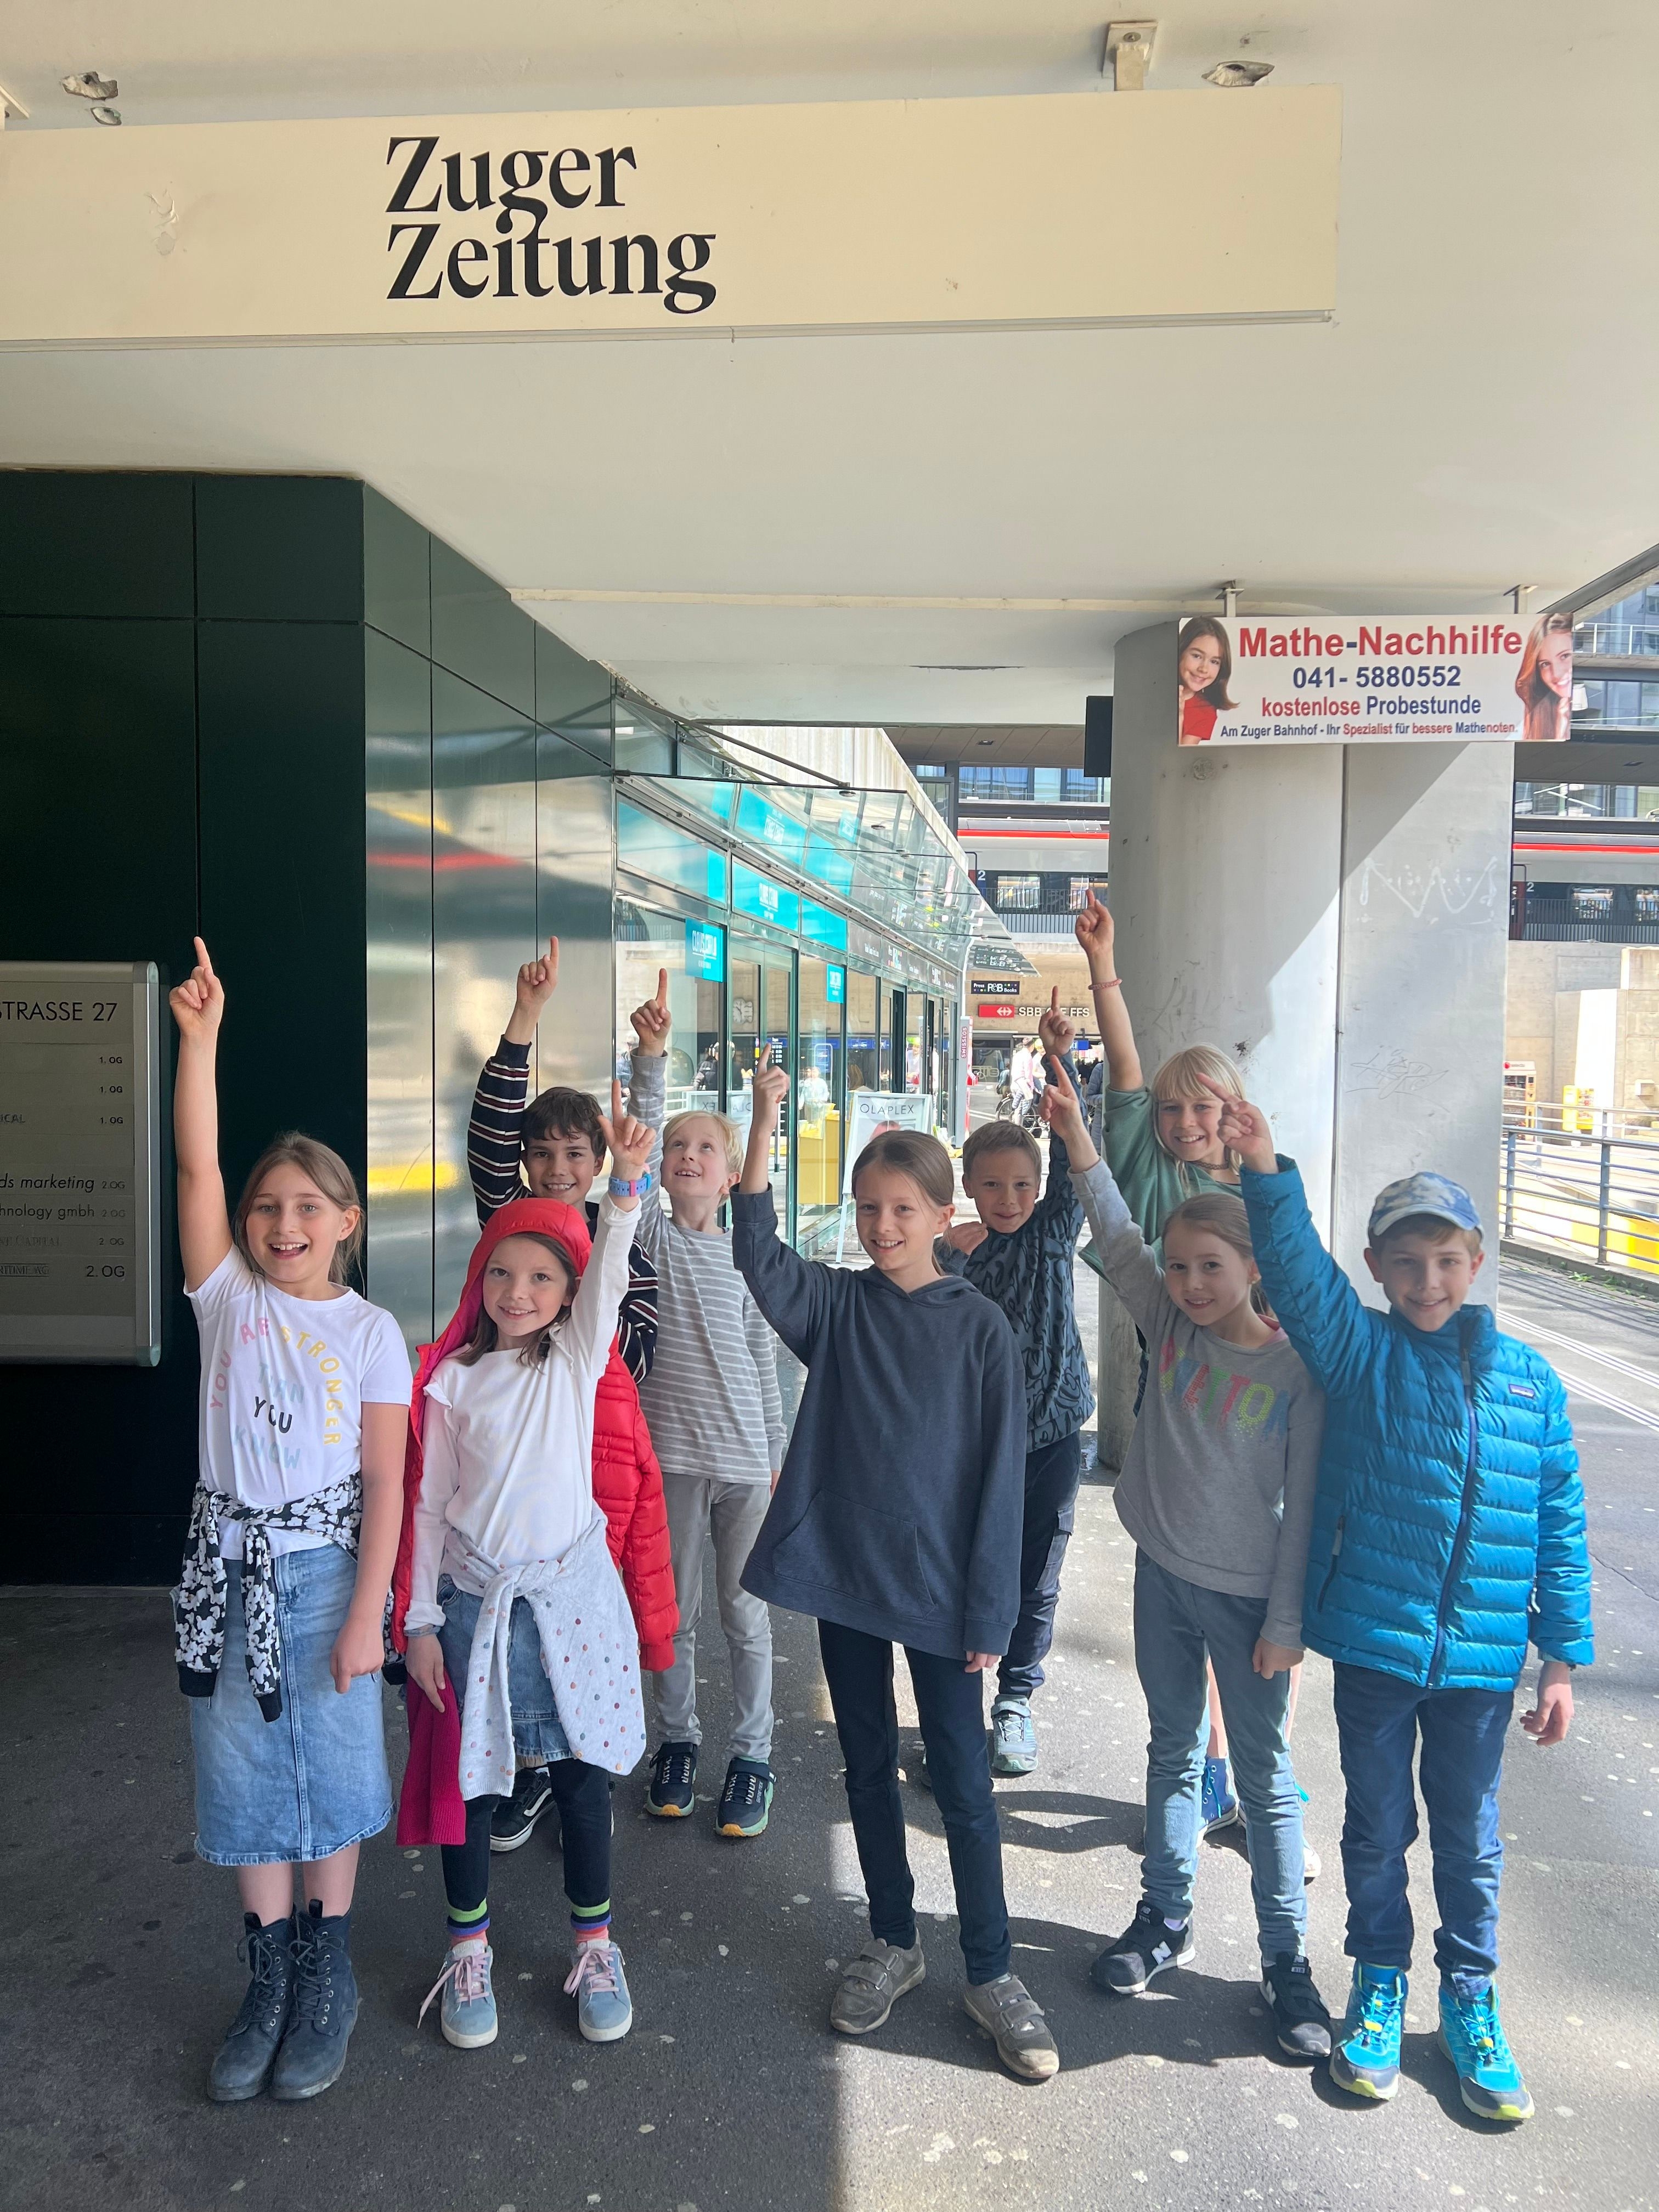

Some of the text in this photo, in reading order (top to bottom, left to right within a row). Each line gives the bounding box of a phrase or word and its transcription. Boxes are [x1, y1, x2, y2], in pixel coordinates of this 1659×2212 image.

[385, 136, 637, 234] Zuger
[386, 223, 716, 314] Zeitung
[1240, 624, 1522, 657] Mathe-Nachhilfe
[1356, 665, 1461, 687] 5880552
[1262, 695, 1481, 716] kostenlose Probestunde
[1221, 726, 1238, 737] Am
[1241, 725, 1271, 739] Zuger
[1274, 724, 1318, 736] Bahnhof
[1327, 723, 1341, 735] Ihr
[1343, 723, 1392, 737] Spezialist
[1395, 723, 1409, 734] für
[1412, 723, 1452, 733] bessere
[978, 870, 986, 881] 2
[1526, 882, 1534, 892] 2
[92, 1002, 117, 1021] 27
[1018, 1007, 1042, 1017] SBB
[1070, 1007, 1090, 1017] FFS
[860, 1103, 915, 1115] OLAPLEX
[21, 1173, 94, 1193] marketing
[58, 1204, 94, 1220] gmbh
[102, 1265, 125, 1277] OG
[210, 1350, 232, 1409] YOU
[280, 1326, 343, 1445] STRONGER
[259, 1363, 304, 1403] TAN
[1152, 1940, 1172, 1965] N
